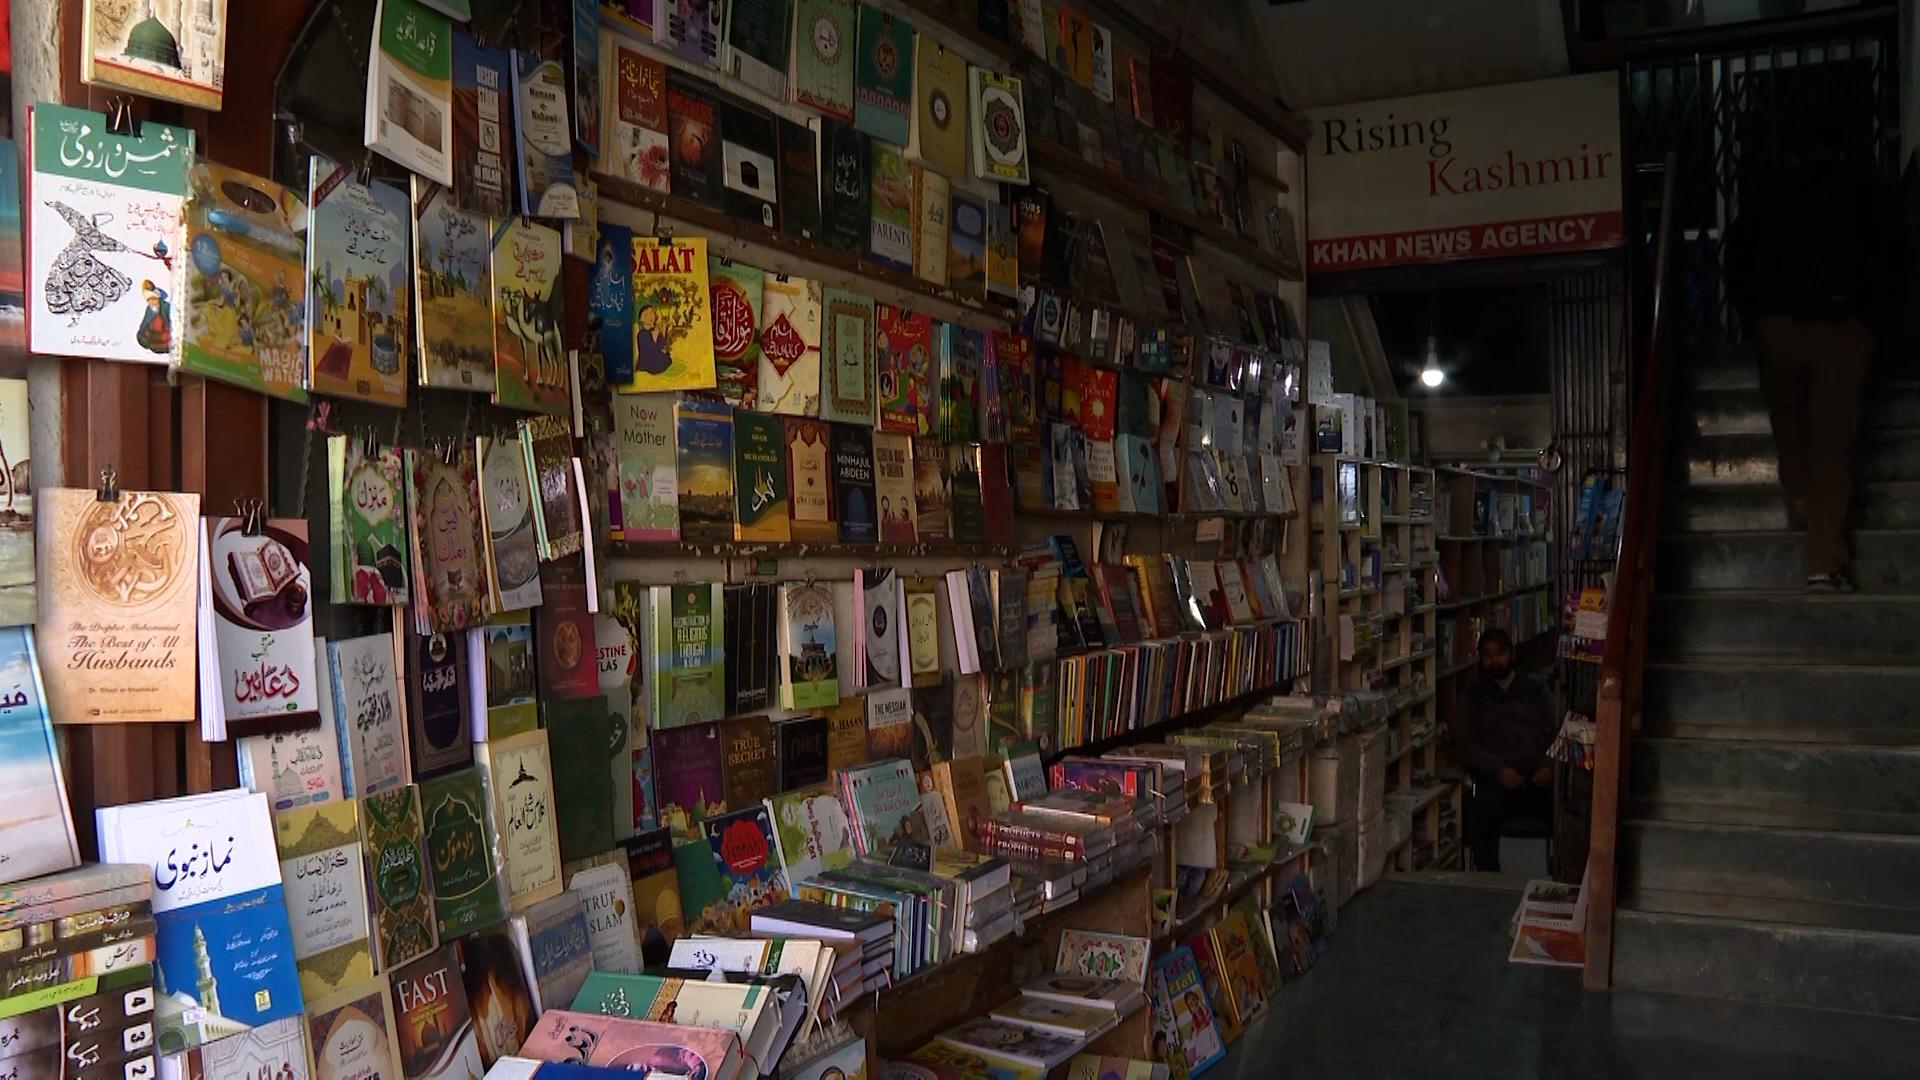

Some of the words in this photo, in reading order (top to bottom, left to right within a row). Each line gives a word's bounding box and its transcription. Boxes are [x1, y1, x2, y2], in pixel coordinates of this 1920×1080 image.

[1322, 112, 1453, 158] Rising
[1426, 143, 1612, 197] Kashmir
[870, 220, 912, 250] PARENTS
[1312, 240, 1389, 265] KHAN
[1395, 229, 1473, 258] NEWS
[1480, 217, 1597, 250] AGENCY
[630, 405, 658, 422] Now
[624, 428, 667, 447] Mother
[839, 467, 871, 481] ABIDEEN
[67, 635, 97, 648] The
[100, 635, 135, 649] Best
[135, 637, 153, 652] of
[595, 645, 627, 660] ESTINE
[66, 649, 177, 670] Husbands
[596, 660, 618, 673] TLAS
[874, 704, 886, 715] THE
[733, 735, 761, 752] TRUE
[727, 747, 767, 766] SECRET
[155, 843, 199, 890] نبوی
[199, 836, 233, 879] نماز
[588, 914, 625, 934] SLAM
[398, 966, 450, 1014] FAST
[131, 997, 146, 1008] 4
[131, 1031, 146, 1043] 3
[132, 1064, 147, 1077] 2
